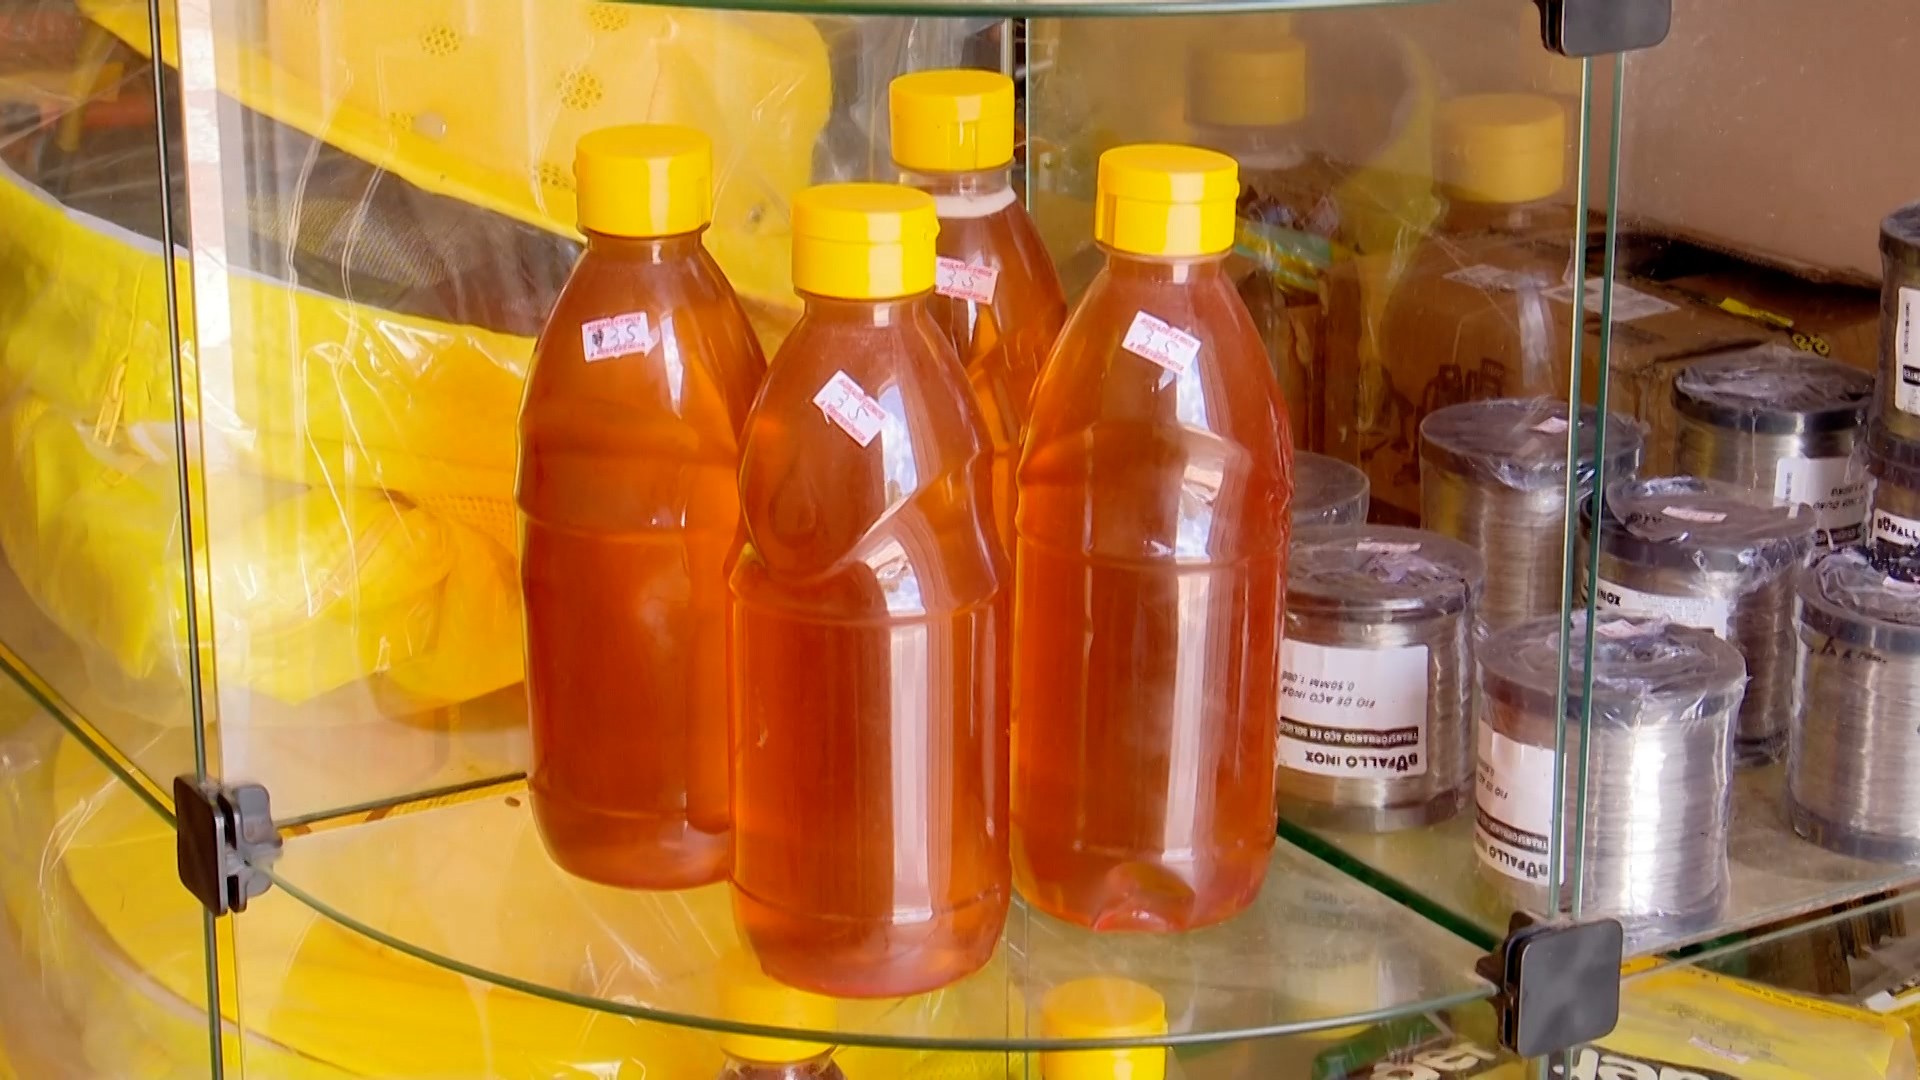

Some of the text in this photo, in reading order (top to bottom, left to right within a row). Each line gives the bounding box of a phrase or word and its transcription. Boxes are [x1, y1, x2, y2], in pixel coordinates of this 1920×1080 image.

[1309, 691, 1334, 705] AÇO
[1337, 696, 1352, 708] DE
[1357, 697, 1376, 709] FIO
[1343, 731, 1418, 746] TRANSFORMANDO
[1304, 750, 1418, 773] BUFALLO INOX
[1489, 845, 1548, 879] BUFALLO
